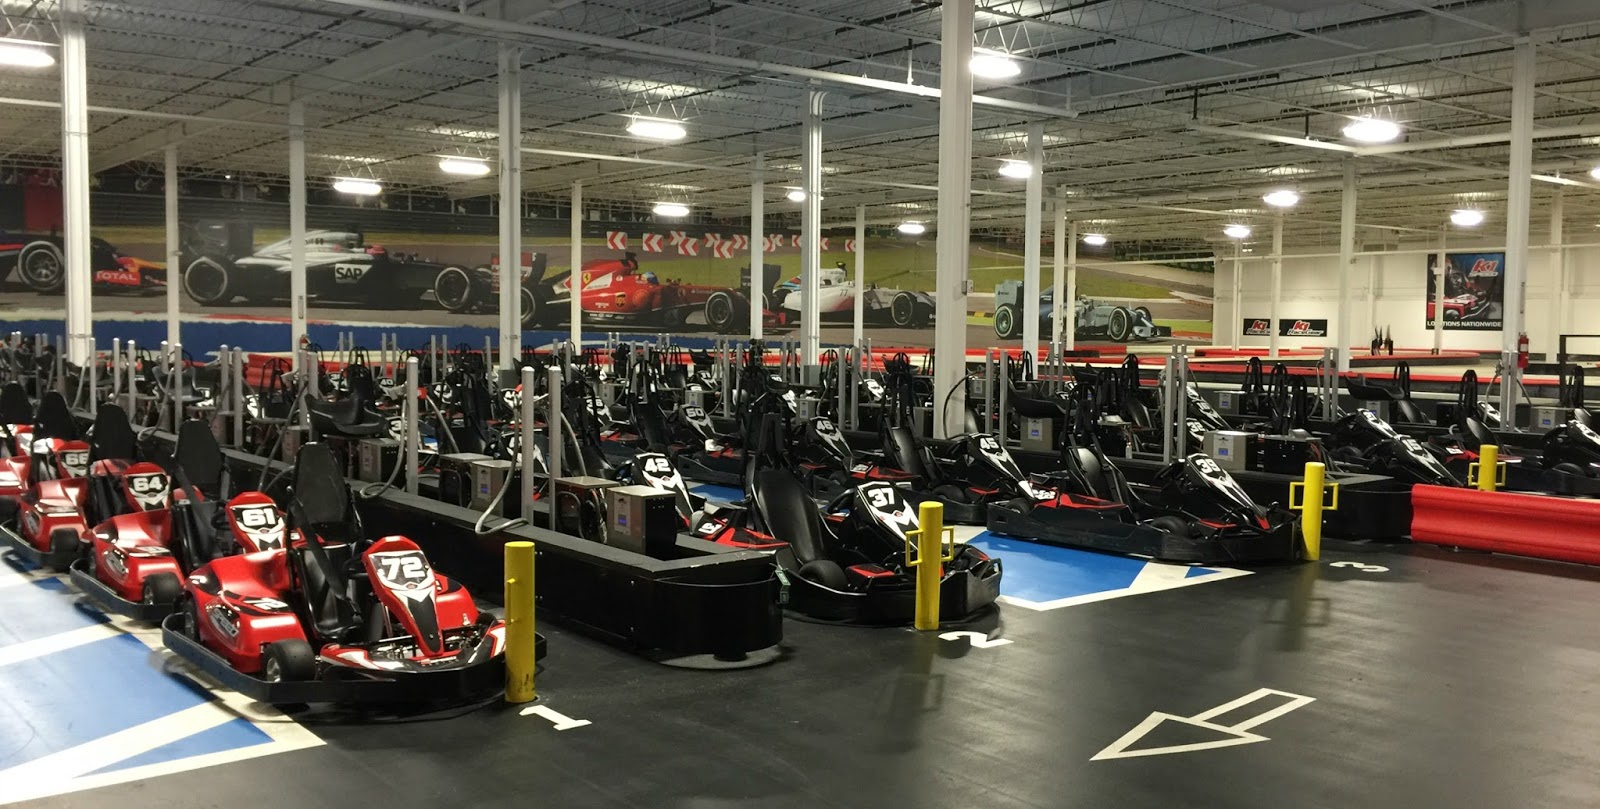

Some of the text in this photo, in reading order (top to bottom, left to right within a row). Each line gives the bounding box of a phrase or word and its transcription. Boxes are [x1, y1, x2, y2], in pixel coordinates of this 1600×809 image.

[1472, 258, 1499, 273] K1
[97, 271, 137, 281] TOTAL
[336, 267, 363, 280] SAP
[1293, 320, 1310, 331] K1
[686, 407, 705, 418] 50
[1186, 421, 1206, 433] 32
[979, 437, 1000, 450] 45
[644, 457, 672, 473] 42
[1195, 458, 1222, 474] 39
[133, 476, 163, 492] 64
[867, 487, 895, 508] 37
[242, 507, 277, 527] 61
[381, 556, 427, 581] 72
[1329, 561, 1390, 572] 3
[938, 631, 1014, 649] 2
[519, 705, 592, 731] 1
